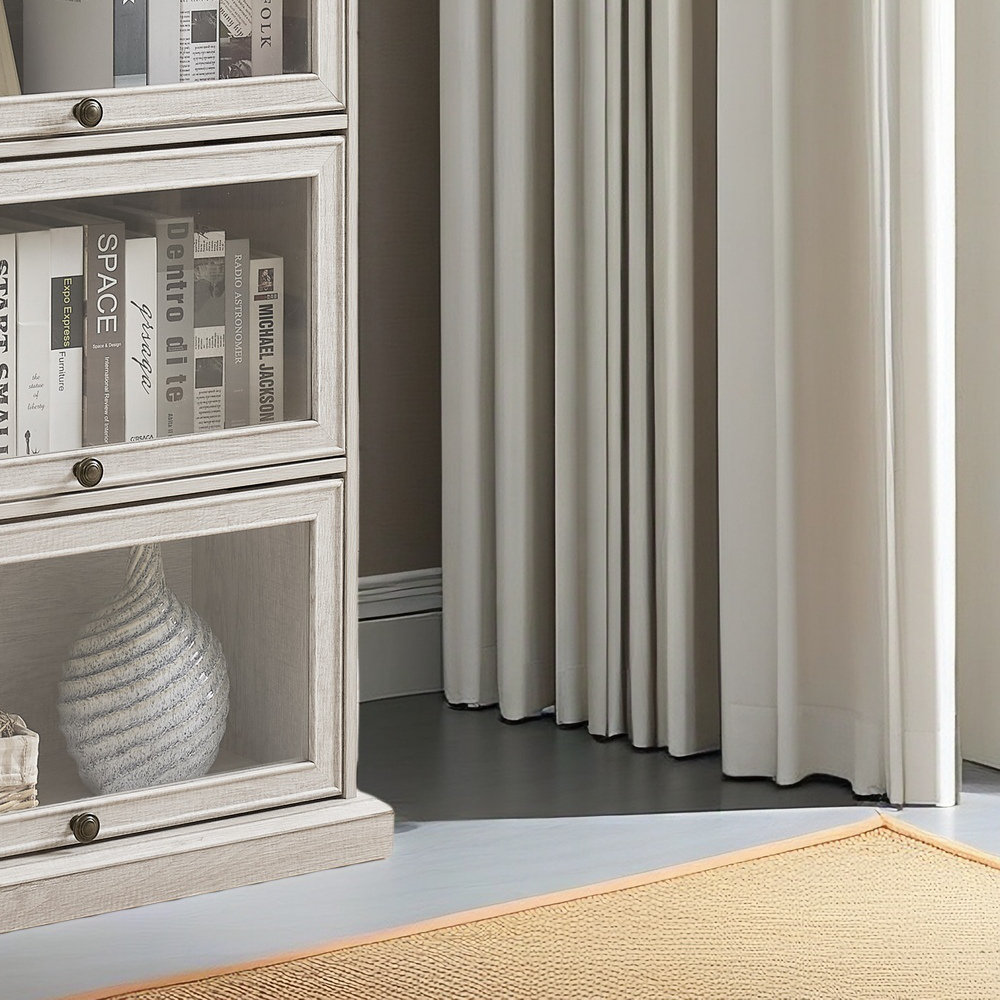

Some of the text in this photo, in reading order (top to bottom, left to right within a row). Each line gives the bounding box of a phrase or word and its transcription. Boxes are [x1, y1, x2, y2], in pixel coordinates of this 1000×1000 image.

[97, 233, 118, 334] SPACE
[165, 223, 189, 323] Dentro
[62, 278, 73, 347] Expo Express
[234, 254, 242, 364] RADIO ASTRONOMER
[258, 303, 275, 360] MICHAEL
[58, 351, 67, 392] Furniture
[258, 363, 275, 422] JACKSON
